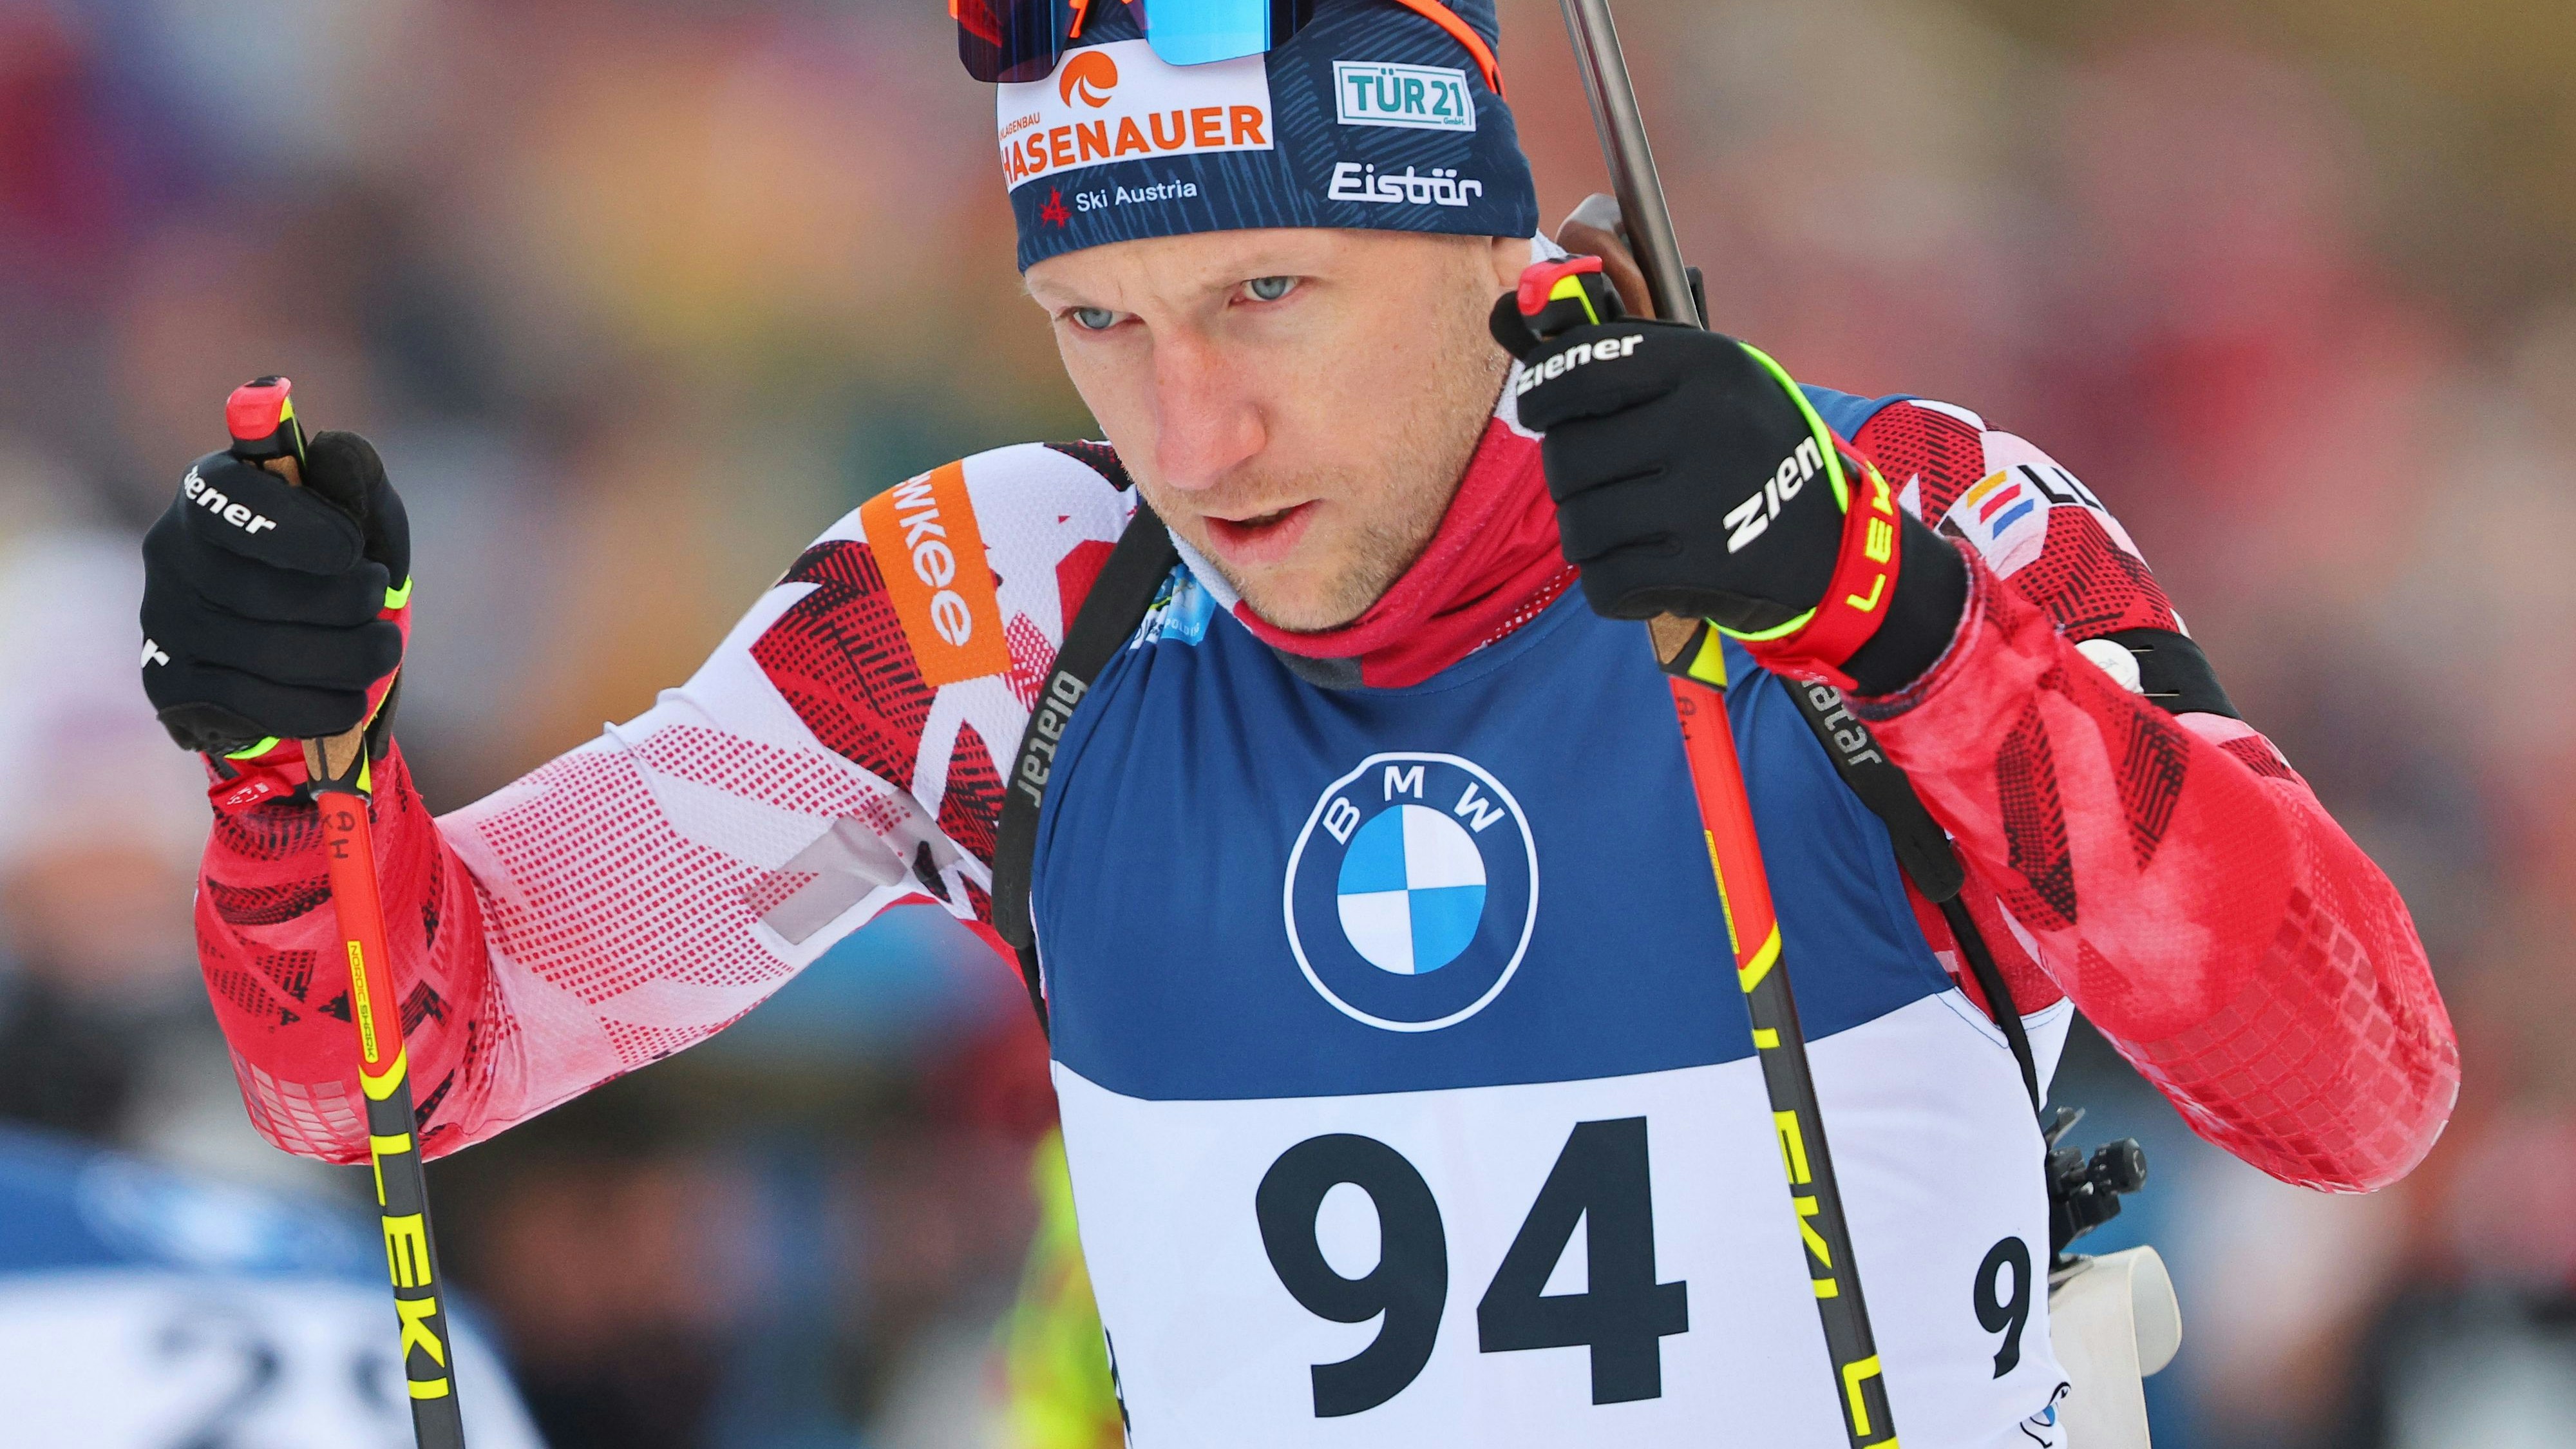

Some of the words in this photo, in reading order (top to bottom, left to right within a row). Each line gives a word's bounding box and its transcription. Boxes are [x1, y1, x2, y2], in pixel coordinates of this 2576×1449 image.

[1347, 68, 1426, 115] TÜR
[1430, 80, 1464, 117] 21
[1000, 104, 1267, 189] HASENAUER
[1327, 161, 1483, 207] Eisbär
[1075, 189, 1109, 213] Ski
[1114, 178, 1198, 207] Austria
[1801, 679, 1882, 766] atar
[1322, 765, 1506, 846] BMW
[350, 945, 366, 1002] NORDIC
[370, 1132, 450, 1400] LEKI
[1255, 1115, 1690, 1418] 94
